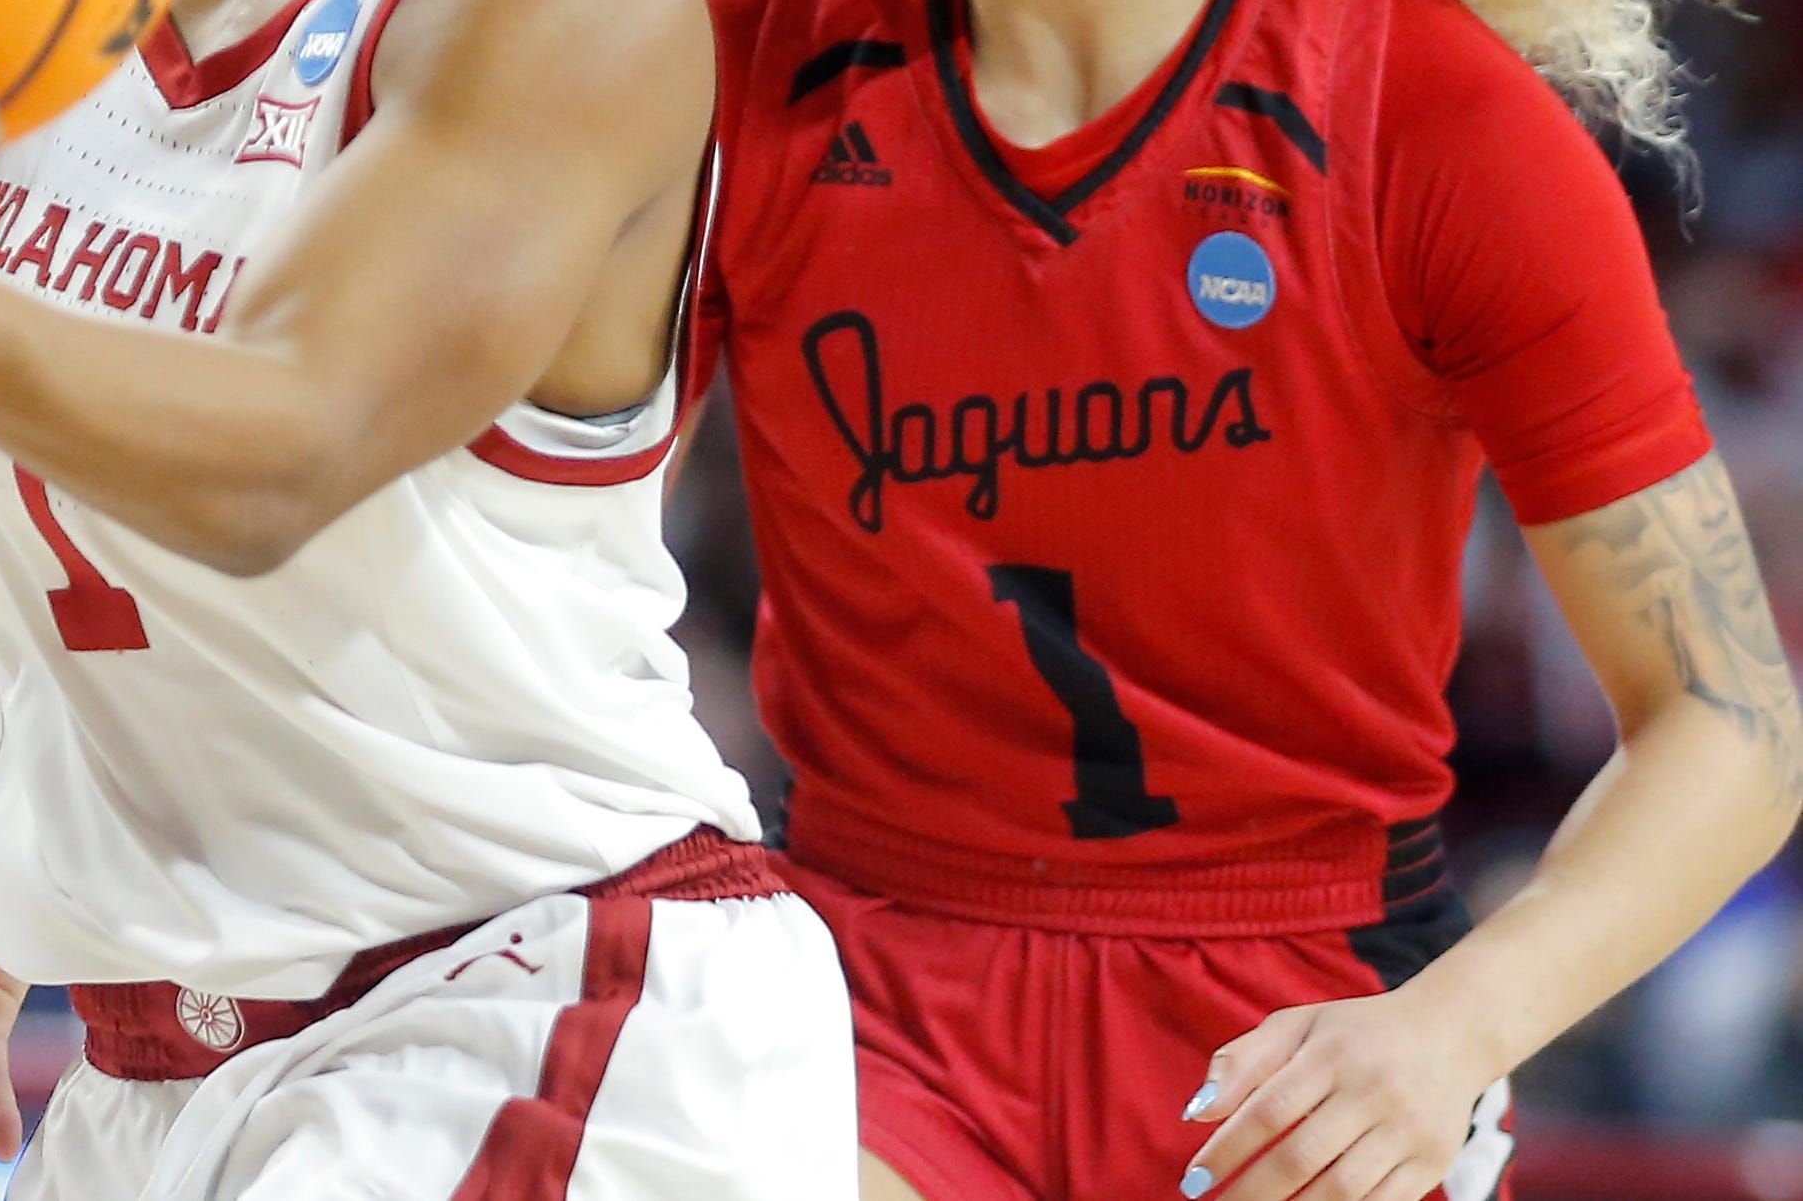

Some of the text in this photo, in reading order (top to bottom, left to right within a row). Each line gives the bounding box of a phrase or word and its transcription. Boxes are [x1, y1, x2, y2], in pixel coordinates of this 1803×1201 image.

[1185, 181, 1290, 218] HORIZON
[1199, 274, 1267, 306] NCAA
[802, 310, 1271, 532] Jaguars
[12, 461, 150, 651] 1
[986, 564, 1180, 839] 1
